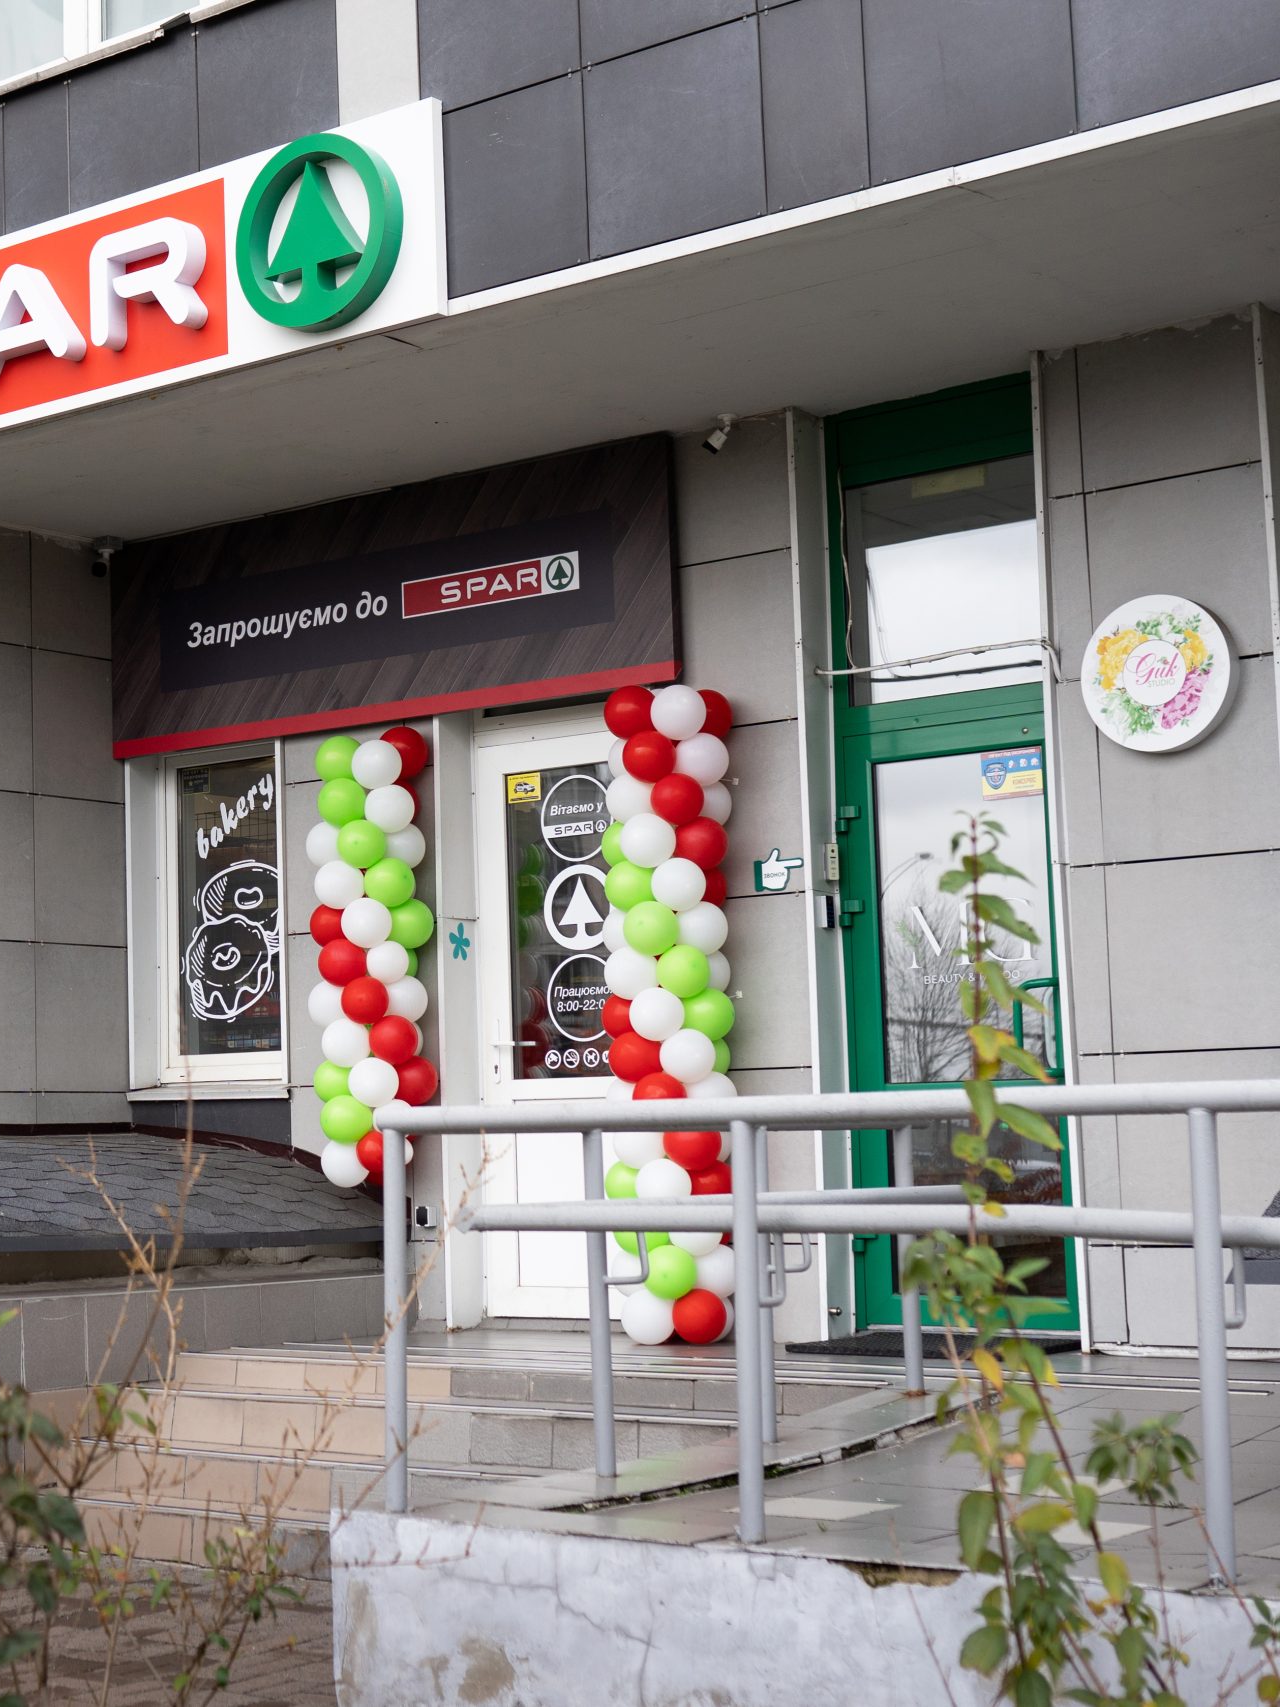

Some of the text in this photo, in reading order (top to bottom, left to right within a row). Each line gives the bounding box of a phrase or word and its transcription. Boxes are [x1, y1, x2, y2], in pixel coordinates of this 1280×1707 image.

[186, 566, 539, 649] Запрошуємо до SPAR
[1148, 678, 1176, 688] STUDIO
[550, 802, 595, 816] Вітаємо
[196, 773, 274, 860] bakery
[554, 823, 593, 836] SPAR
[923, 973, 967, 985] BEAUTY
[556, 998, 606, 1012] 8:00-22:0
